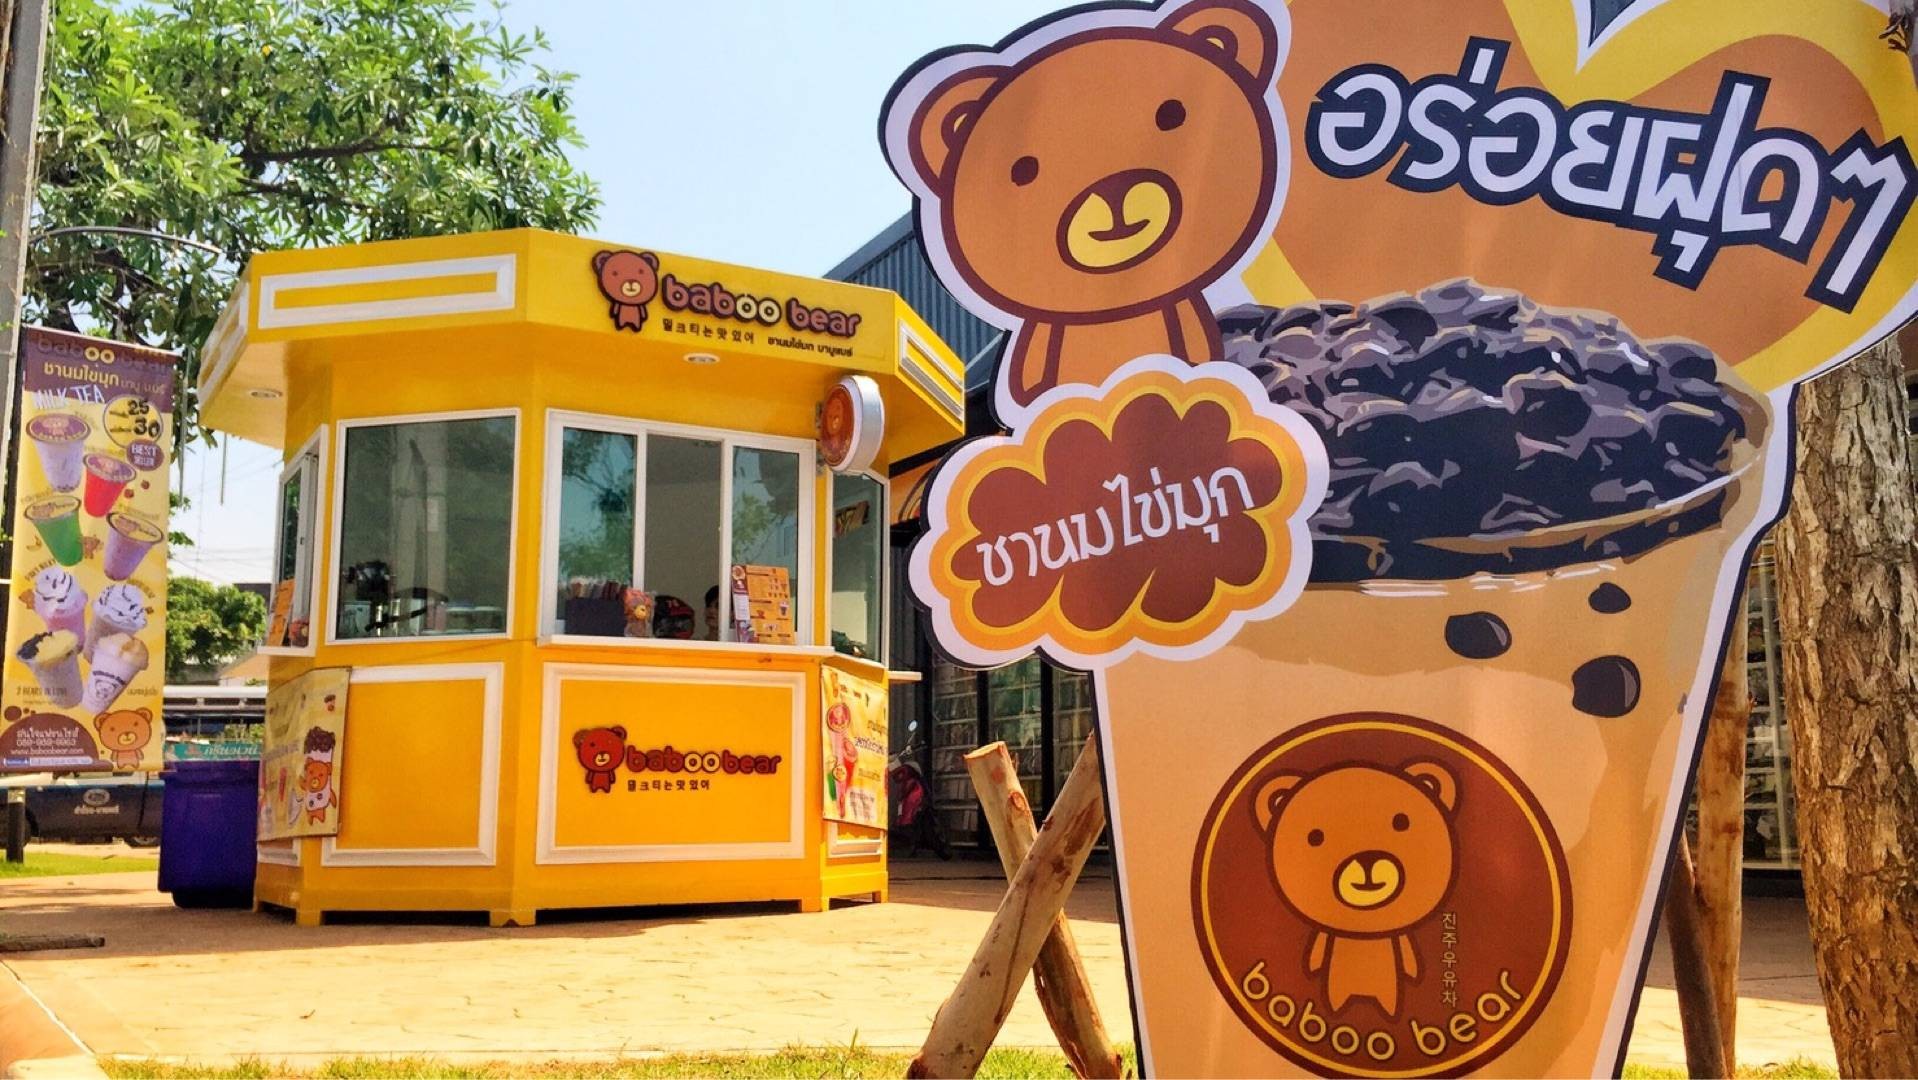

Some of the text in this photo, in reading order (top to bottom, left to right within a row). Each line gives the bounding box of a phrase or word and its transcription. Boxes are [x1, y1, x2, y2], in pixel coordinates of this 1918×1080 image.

[1308, 40, 1914, 308] อร่อยฝุดๆ
[662, 274, 862, 338] baboo bear
[128, 399, 150, 416] 25
[133, 416, 161, 438] 30
[131, 444, 157, 457] BEST
[976, 466, 1254, 586] ชานมไข่มุก
[1242, 961, 1522, 1061] baboo bear
